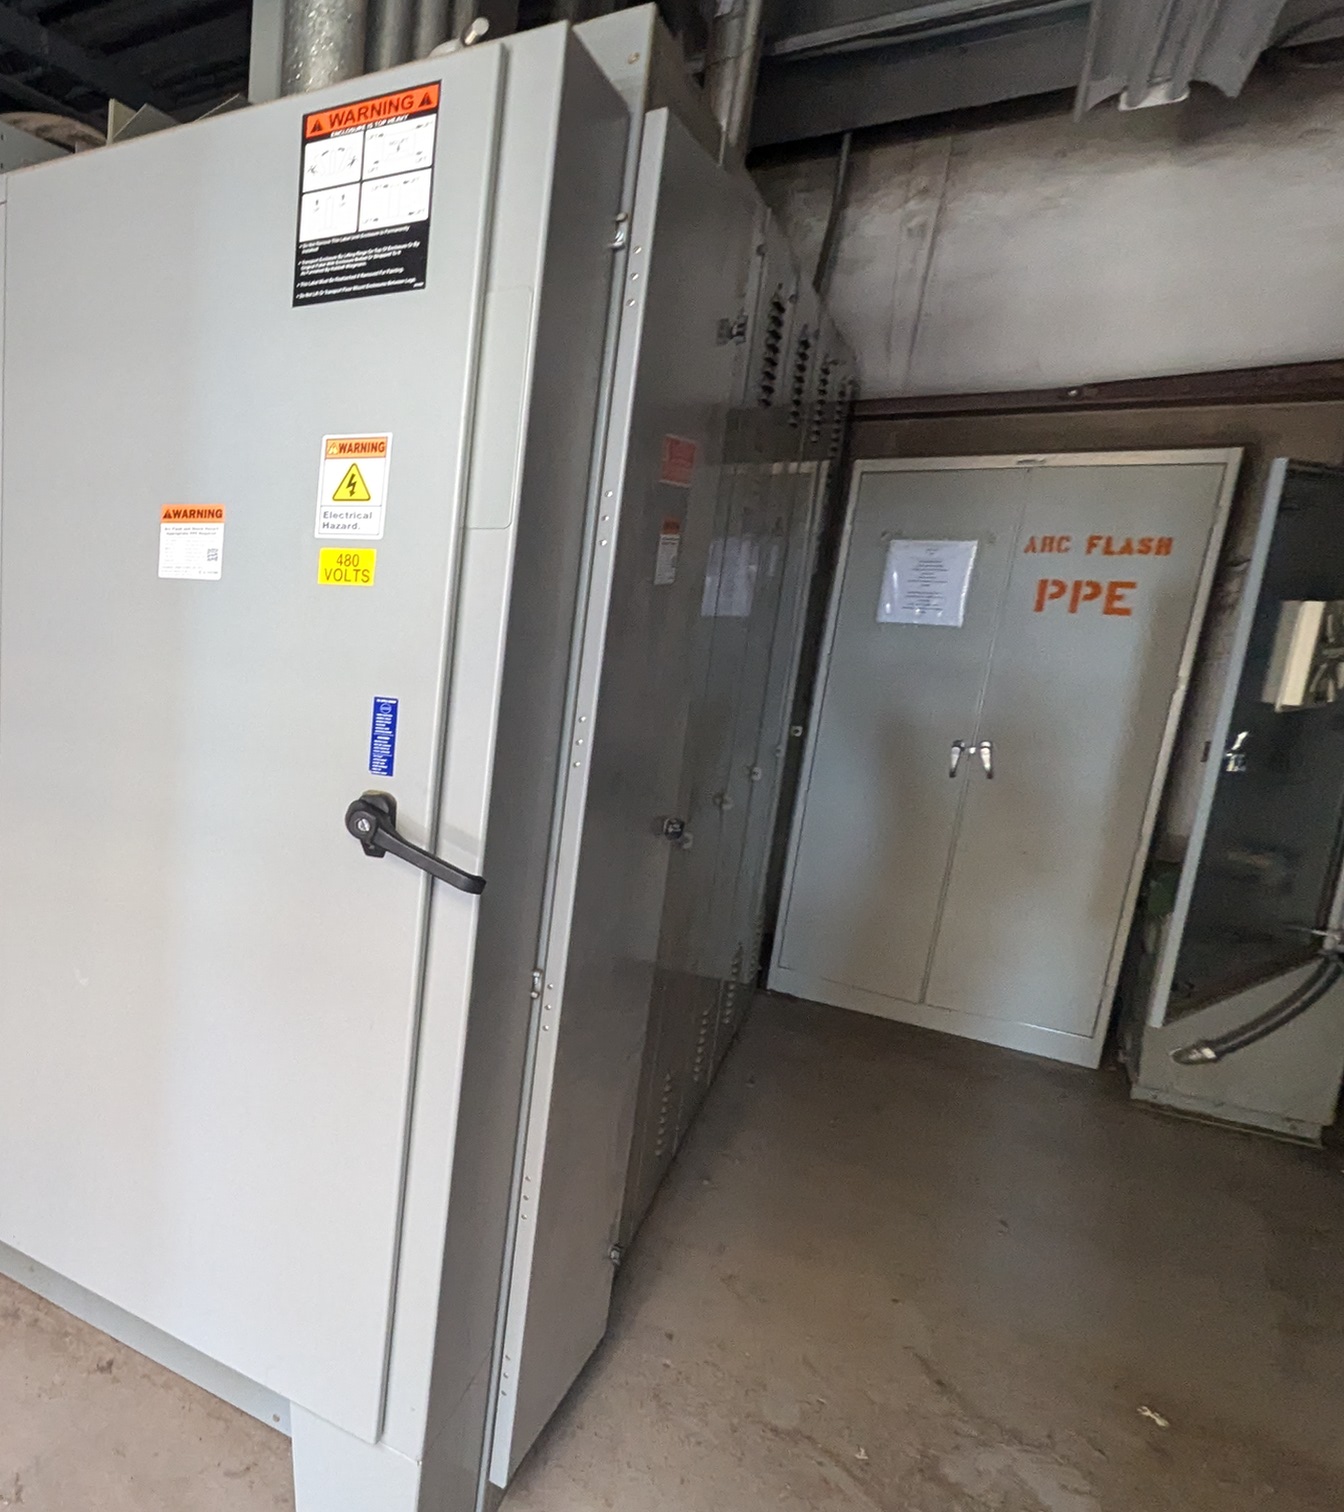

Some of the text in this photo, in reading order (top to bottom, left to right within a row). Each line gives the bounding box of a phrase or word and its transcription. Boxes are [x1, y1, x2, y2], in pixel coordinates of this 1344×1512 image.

[328, 94, 414, 128] WARNING
[338, 441, 386, 454] WARNING
[172, 509, 223, 519] WARNING
[323, 511, 373, 520] Electrical
[322, 522, 361, 530] Hazard.
[1024, 535, 1174, 556] ARC FLASH
[336, 553, 360, 567] 480
[324, 568, 370, 583] VOLTS
[1033, 578, 1138, 616] PPE
